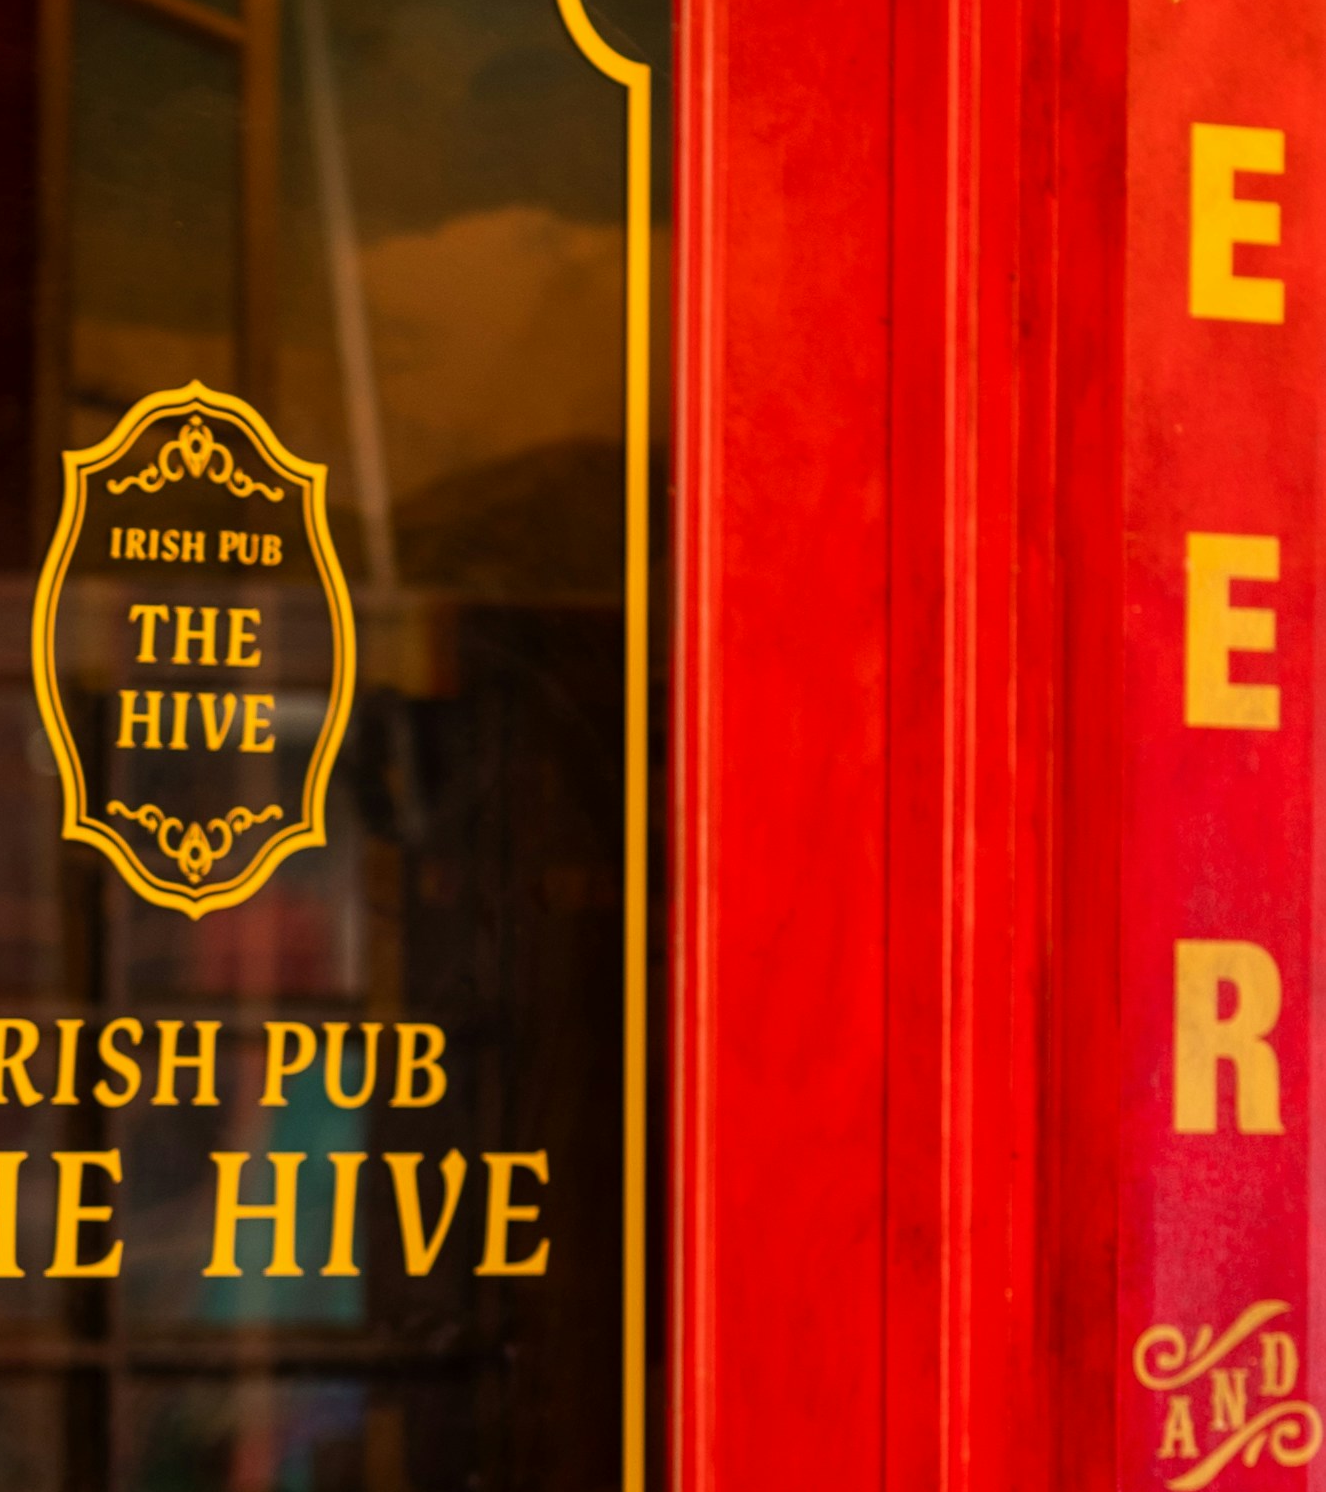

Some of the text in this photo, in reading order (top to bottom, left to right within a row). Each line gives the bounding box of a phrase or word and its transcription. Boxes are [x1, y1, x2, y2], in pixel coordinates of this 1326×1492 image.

[110, 526, 283, 566] IRISH PUB
[128, 604, 262, 668] THE
[116, 690, 277, 754] HIVE
[259, 1020, 447, 1110] PUB
[202, 1150, 550, 1278] HIVE
[1155, 1331, 1299, 1459] AND
